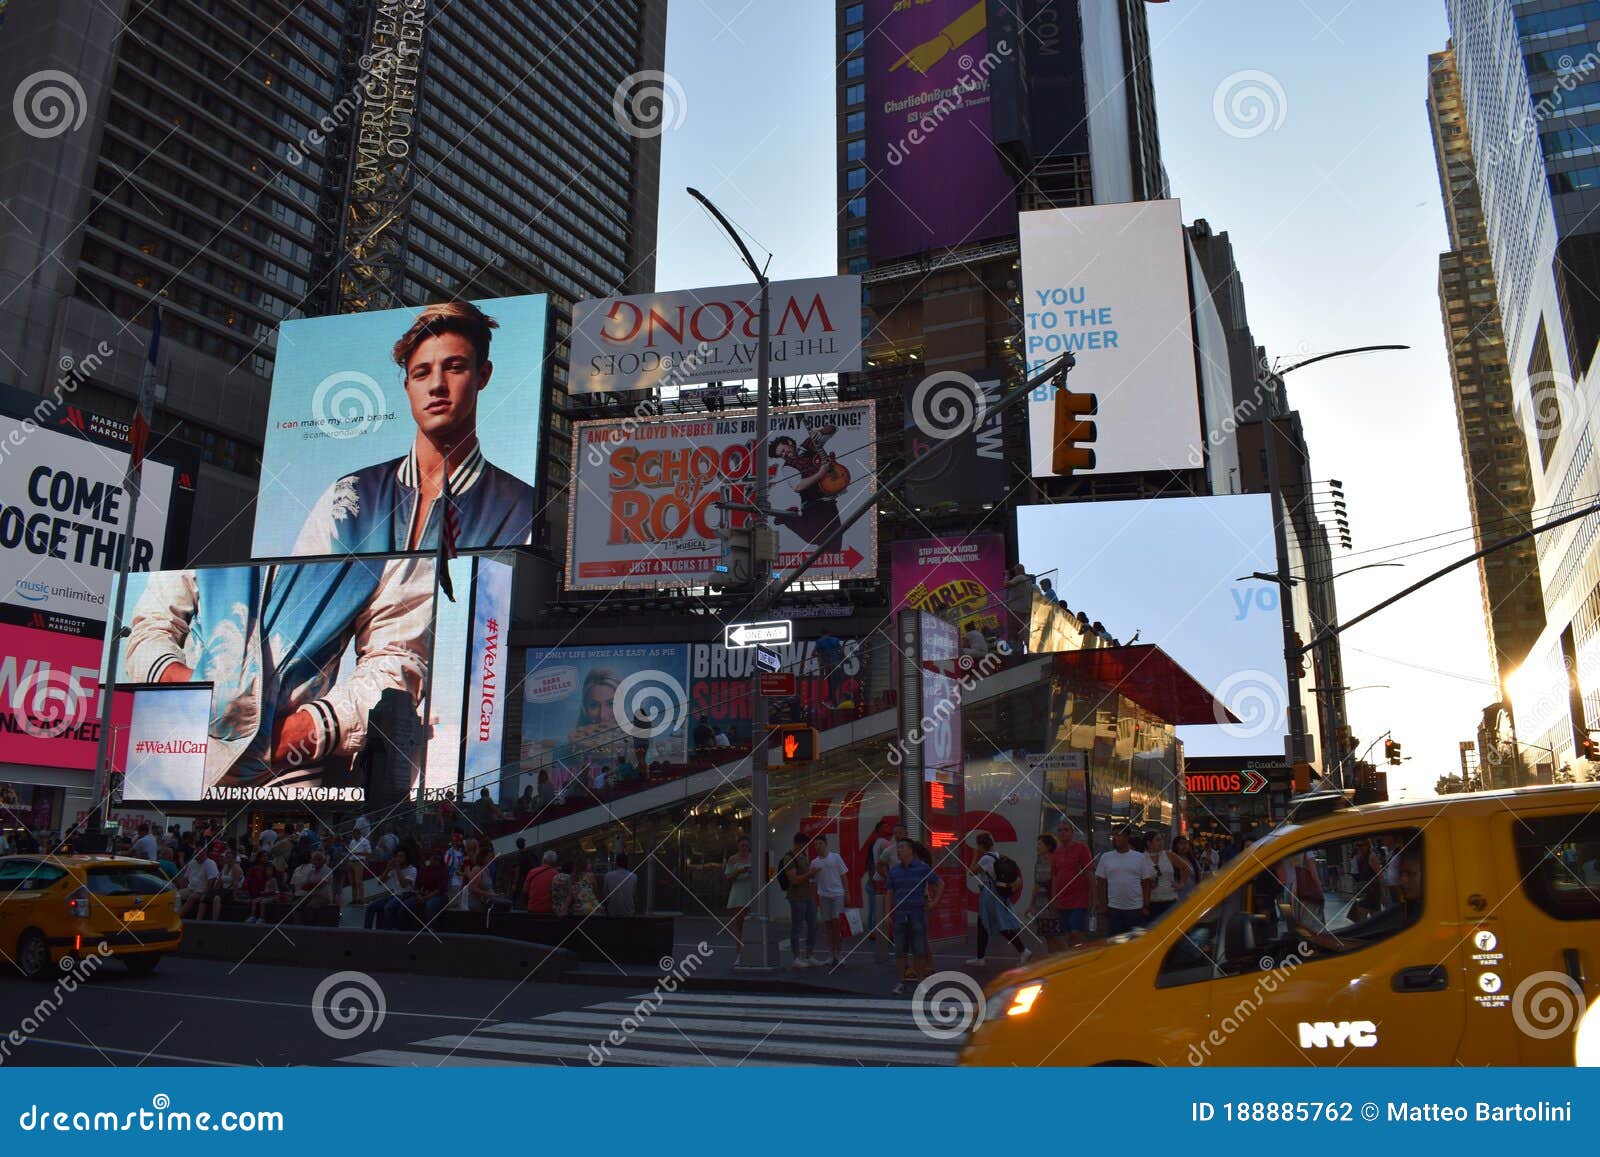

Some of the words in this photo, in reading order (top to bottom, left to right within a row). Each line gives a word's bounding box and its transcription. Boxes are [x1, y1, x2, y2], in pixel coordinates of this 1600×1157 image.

[354, 43, 393, 194] AMERICAN
[1036, 286, 1086, 306] YOU
[600, 293, 840, 348] WRONG
[1026, 310, 1058, 329] TO
[1064, 307, 1113, 328] THE
[791, 336, 839, 357] THE
[1029, 329, 1119, 354] POWER
[590, 350, 662, 377] GOES
[91, 415, 132, 432] MARRIO
[282, 421, 298, 429] can
[301, 418, 325, 428] make
[327, 417, 341, 426] my
[344, 415, 364, 424] own
[367, 411, 397, 422] brand.
[634, 424, 668, 441] LLOYD
[671, 422, 714, 438] WEBBER
[716, 420, 738, 435] HAS
[741, 413, 803, 433] BRODWAY
[90, 424, 129, 442] MARQUI
[28, 465, 123, 525] COME
[0, 504, 154, 573] OGETHER
[630, 561, 650, 573] JUST
[662, 559, 695, 571] BLOCKS
[699, 559, 708, 570] TO
[771, 554, 804, 567] ARDEN
[16, 578, 49, 595] music
[51, 581, 105, 606] unlimited
[48, 623, 82, 635] MARQUIS
[49, 616, 86, 628] MARRIOTT
[569, 651, 586, 659] LIFE
[588, 650, 613, 658] WERE
[613, 649, 624, 657] AS
[626, 649, 647, 657] EASY
[649, 648, 660, 656] AS
[478, 617, 499, 743] #WeAllCan
[135, 740, 208, 755] #WeAllCan
[202, 786, 290, 801] AMERICAN
[295, 786, 347, 801] EAGLE
[1297, 1020, 1378, 1049] NYC
